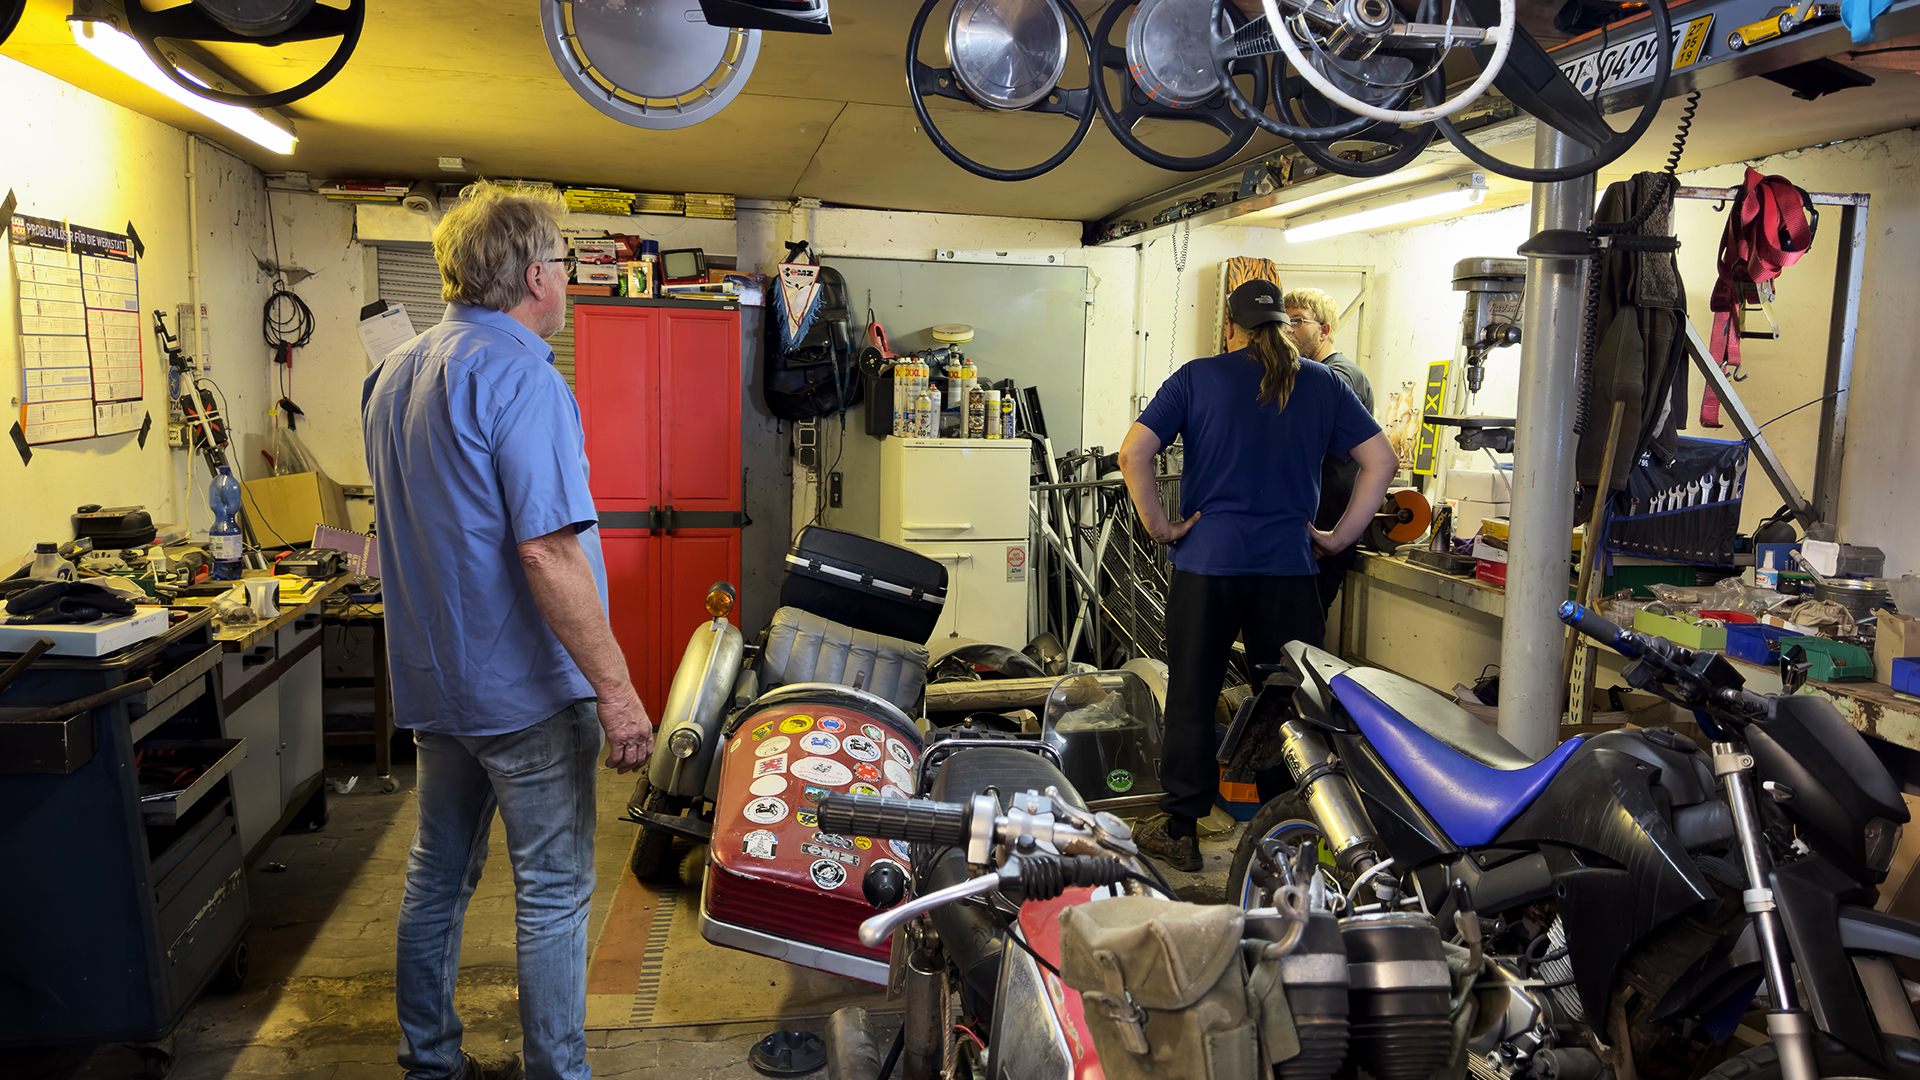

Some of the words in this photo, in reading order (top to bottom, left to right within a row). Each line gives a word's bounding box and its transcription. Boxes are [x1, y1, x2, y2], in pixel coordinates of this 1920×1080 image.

[1688, 22, 1704, 36] 27
[1683, 36, 1698, 50] 05
[1679, 50, 1692, 63] 19
[26, 222, 74, 242] PROBLEMLÖSR
[74, 230, 87, 245] FÜR
[87, 235, 97, 247] DIE
[97, 237, 127, 251] WERKSTATT
